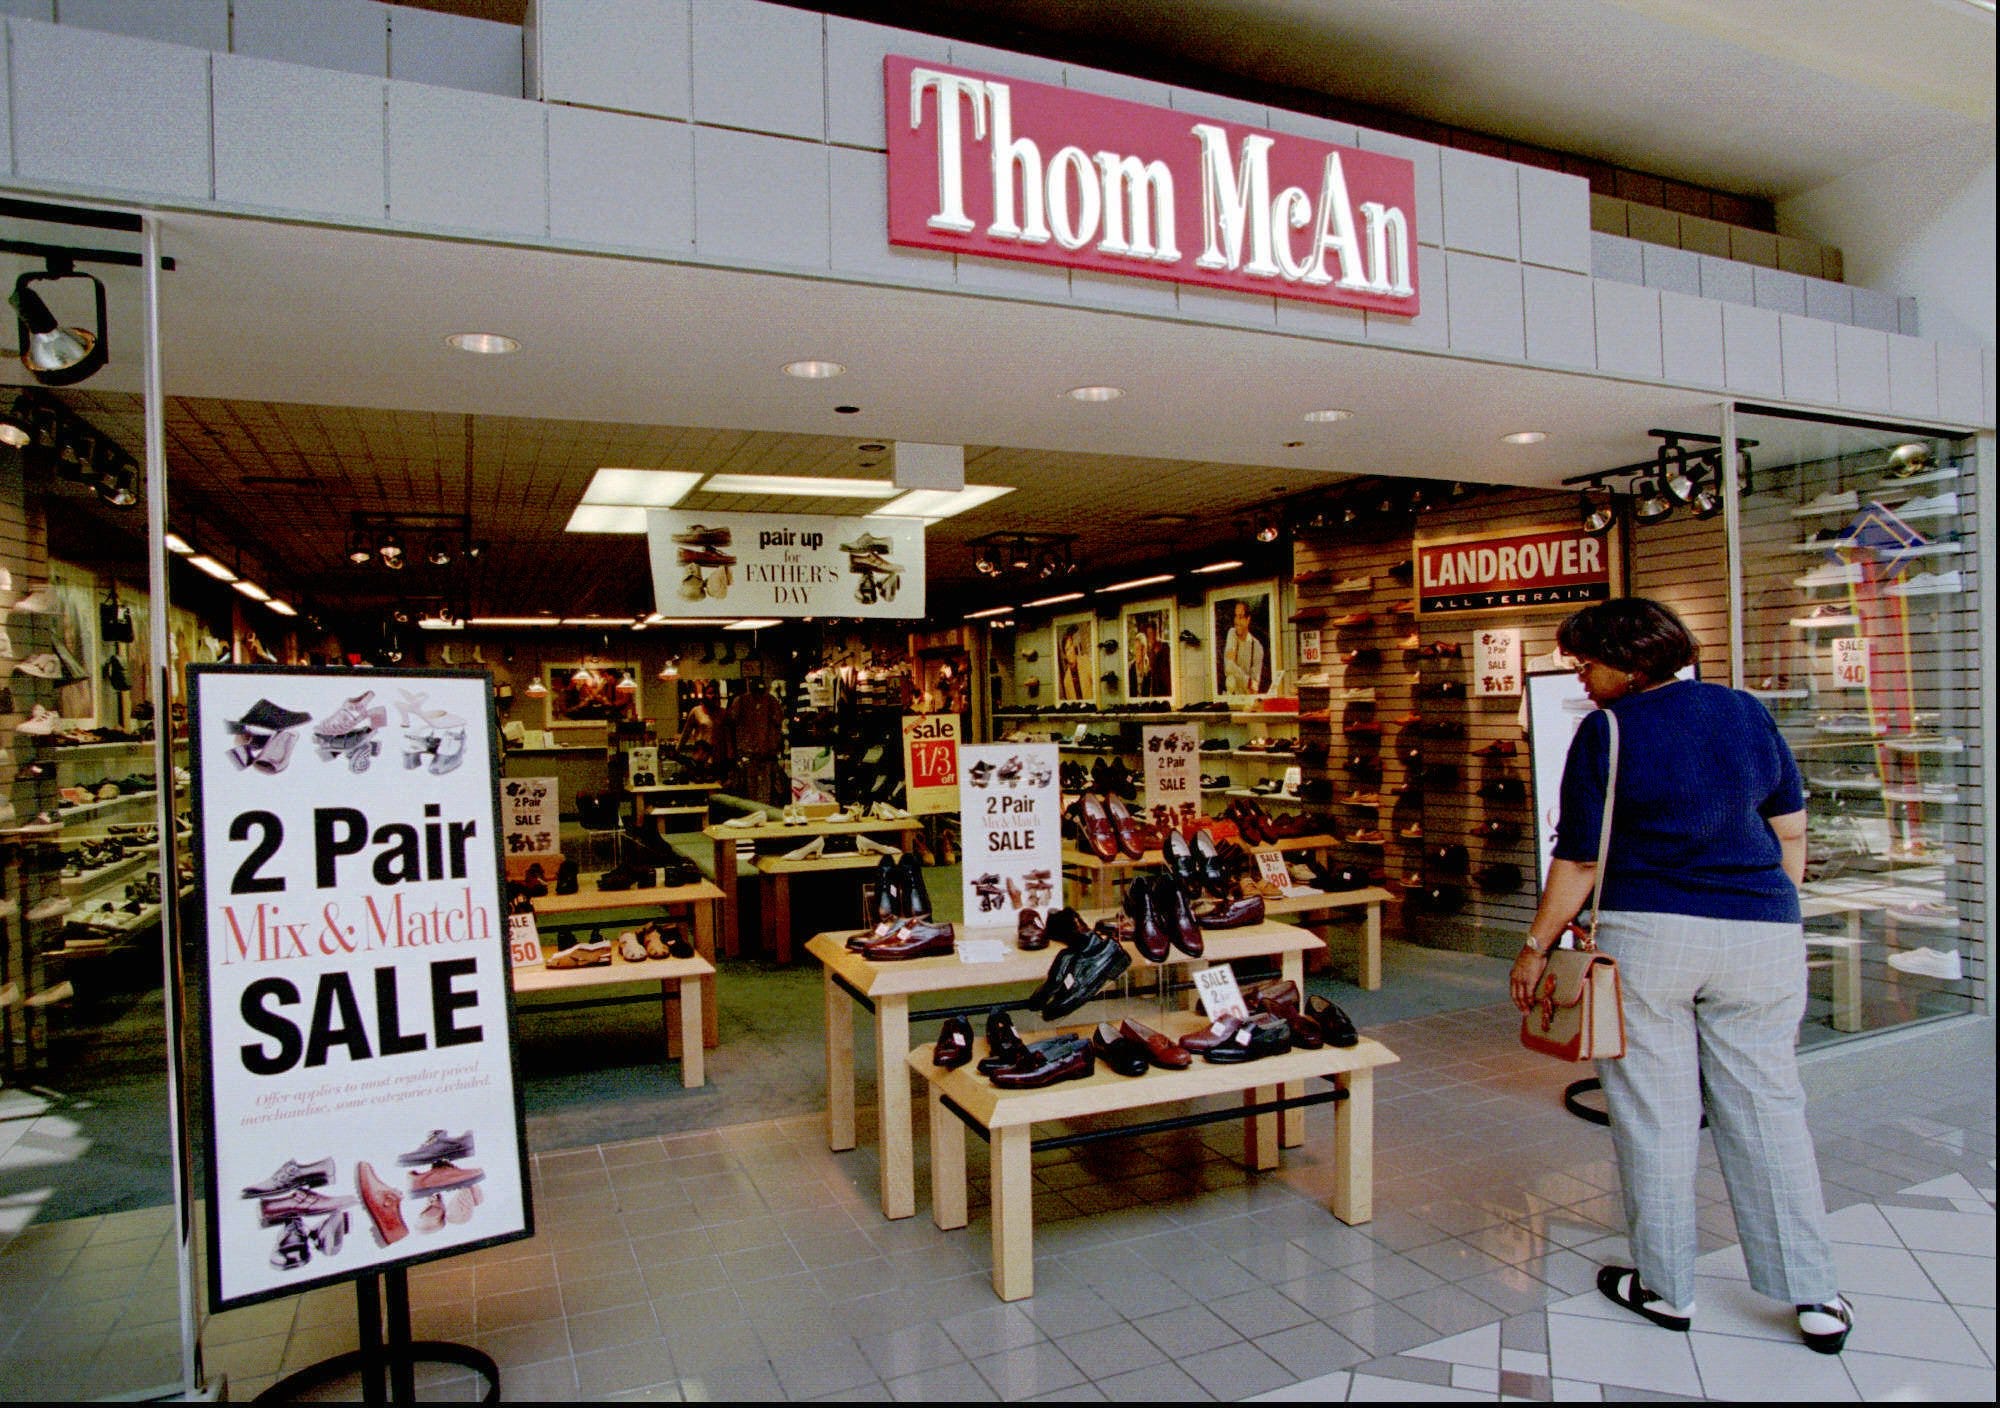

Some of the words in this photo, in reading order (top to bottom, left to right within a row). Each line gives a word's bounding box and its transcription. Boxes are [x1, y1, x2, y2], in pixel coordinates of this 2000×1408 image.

[911, 69, 1182, 263] Thom
[1191, 123, 1414, 297] McAn
[760, 528, 796, 549] pair
[801, 532, 823, 550] up
[784, 551, 801, 563] for
[1423, 538, 1601, 587] LANDROVER
[746, 564, 839, 583] FATHER'S
[774, 586, 812, 604] DAY
[1435, 599, 1472, 609] ALL
[1485, 590, 1590, 605] TERRAIN
[1838, 640, 1865, 651] SALE
[1488, 660, 1506, 671] SALE
[1842, 652, 1849, 662] 2
[1838, 665, 1866, 683] $40
[912, 718, 954, 739] sale
[916, 746, 952, 776] 1/3
[1158, 758, 1165, 769] 2
[1167, 757, 1186, 768] Pair
[941, 774, 955, 784] off
[1160, 778, 1186, 791] SALE
[514, 797, 521, 807] 2
[523, 797, 541, 807] Pair
[987, 796, 998, 814] 2
[1002, 794, 1035, 813] Pair
[515, 815, 541, 826] SALE
[228, 810, 286, 895] 2
[313, 803, 477, 889] Pair
[988, 830, 1035, 852] SALE
[1260, 853, 1280, 863] SALE
[219, 903, 312, 965] Mix
[319, 902, 356, 956] &
[361, 887, 493, 951] Match
[509, 916, 529, 928] ALE
[511, 942, 537, 962] 50
[1201, 970, 1229, 989] SALE
[1211, 990, 1220, 1004] 2
[240, 957, 484, 1076] SALE
[256, 1091, 291, 1109] Offer
[293, 1083, 341, 1103] applies
[344, 1082, 358, 1092] to
[360, 1076, 393, 1091] most
[394, 1068, 440, 1086] regular
[440, 1060, 479, 1081] priced
[370, 1086, 433, 1103] categories
